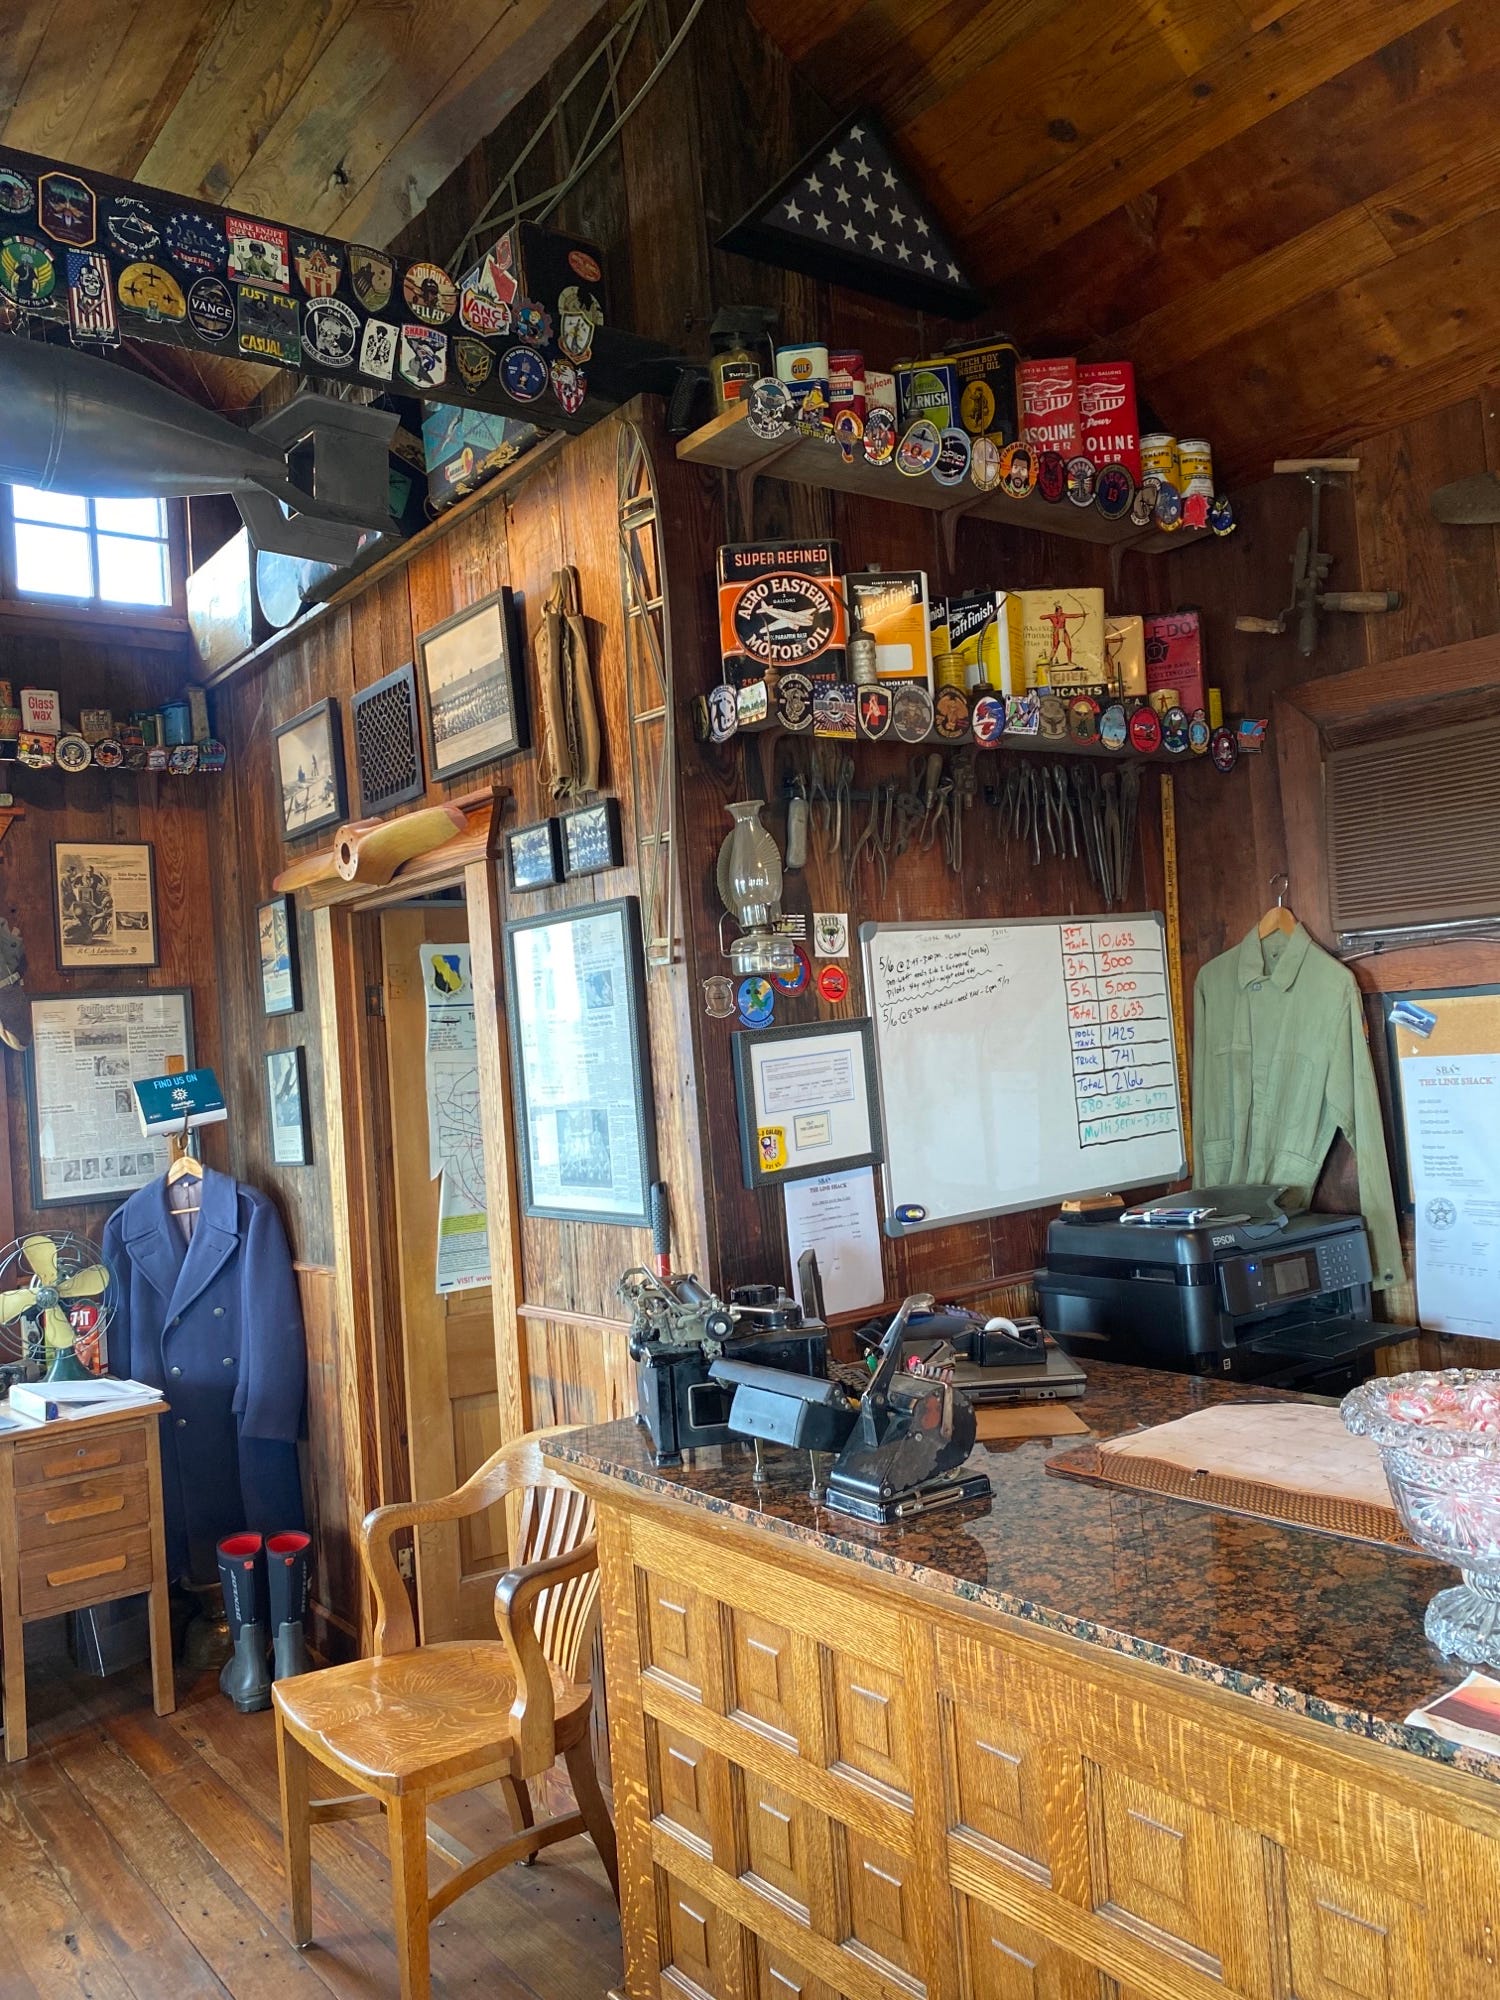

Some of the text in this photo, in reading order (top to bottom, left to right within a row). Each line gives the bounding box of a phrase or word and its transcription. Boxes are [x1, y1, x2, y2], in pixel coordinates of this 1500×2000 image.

[229, 219, 254, 232] MAKE
[229, 226, 284, 246] GREAT AGAIN
[412, 267, 430, 280] YOU
[239, 287, 297, 310] JUST FLY
[464, 292, 509, 321] VANCE
[191, 297, 233, 319] VANCE
[472, 314, 499, 328] DRY
[241, 334, 285, 357] CASUAL
[981, 353, 998, 363] BOY
[986, 362, 1000, 370] OIL
[792, 365, 811, 375] GULF
[734, 548, 828, 567] SUPER REFINED
[737, 577, 832, 621] AERO EASTERN
[854, 592, 890, 620] Aircraft
[1152, 620, 1193, 640] EDO
[745, 626, 831, 661] MOTOR OIL
[27, 695, 55, 710] Glass
[32, 710, 52, 721] wax
[1063, 927, 1135, 949] JET 10,633
[896, 961, 906, 973] @
[1101, 951, 1134, 973] 3000
[1104, 979, 1137, 996] 5,000
[1108, 1026, 1136, 1041] 1425
[1075, 1048, 1136, 1065] TRUCK 741
[153, 1073, 198, 1090] FIND US ON
[1112, 1070, 1144, 1091] 2166
[1418, 1076, 1496, 1088] THE LINE SHACK
[819, 1184, 831, 1193] LINE
[830, 1182, 848, 1191] SHACK
[1211, 1233, 1236, 1247] EPSON
[456, 1275, 474, 1285] VISIT
[230, 1569, 242, 1622] DUNLOP
